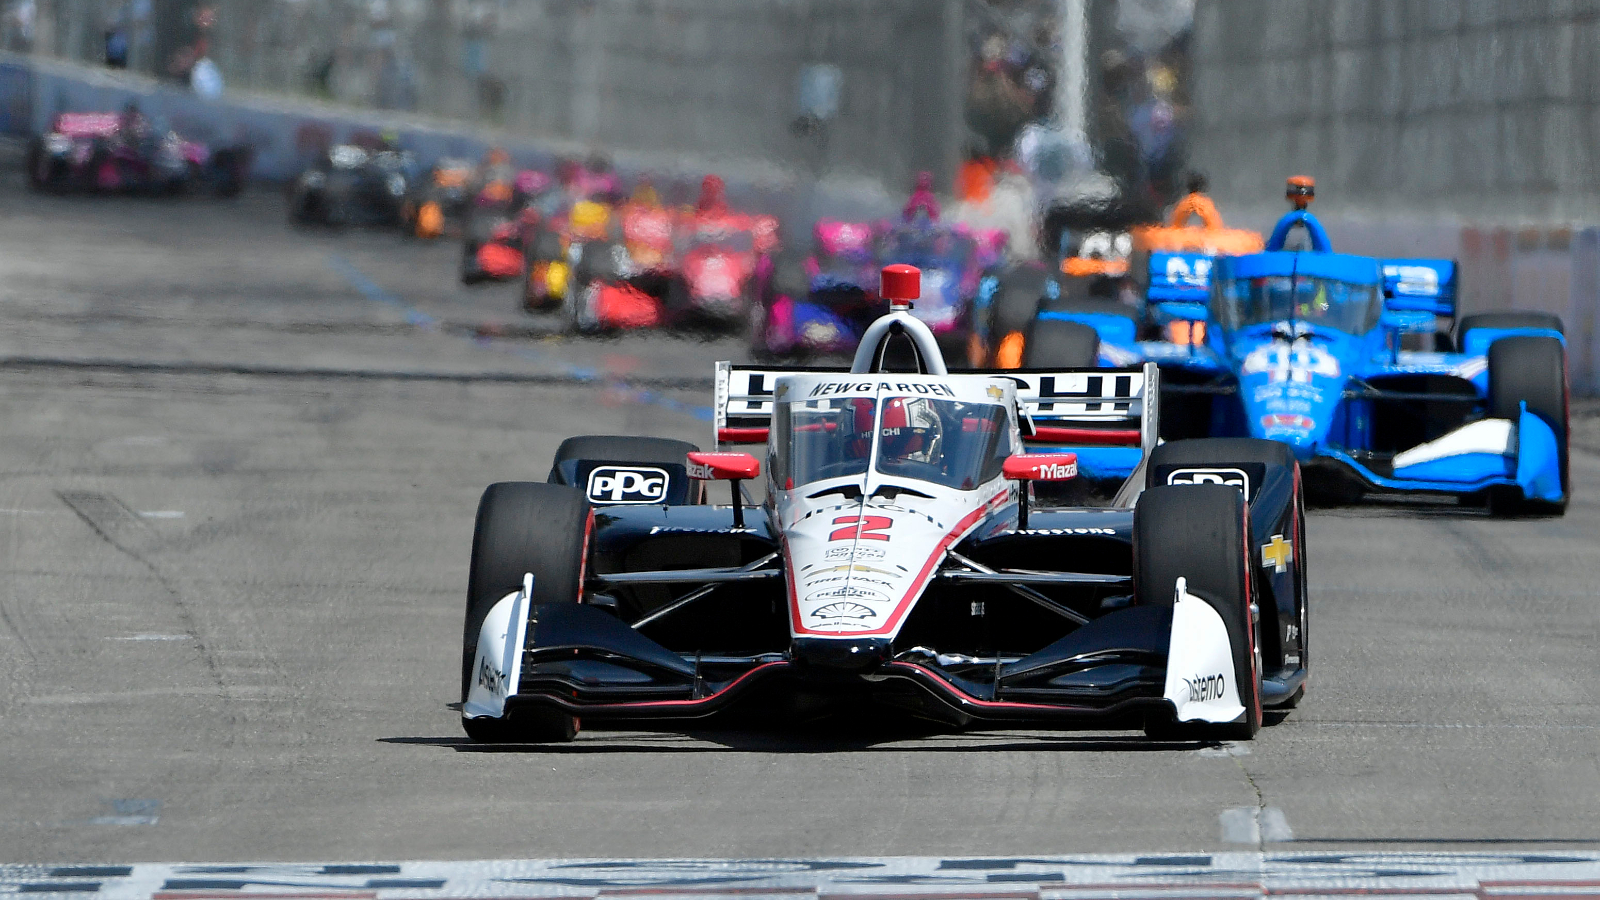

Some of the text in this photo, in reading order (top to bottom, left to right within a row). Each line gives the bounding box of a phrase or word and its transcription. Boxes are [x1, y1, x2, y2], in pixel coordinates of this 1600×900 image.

[809, 382, 956, 397] NEWGARDEN
[861, 427, 901, 439] HICHI
[687, 461, 715, 480] zak
[592, 471, 663, 500] PPG
[828, 514, 894, 542] 2
